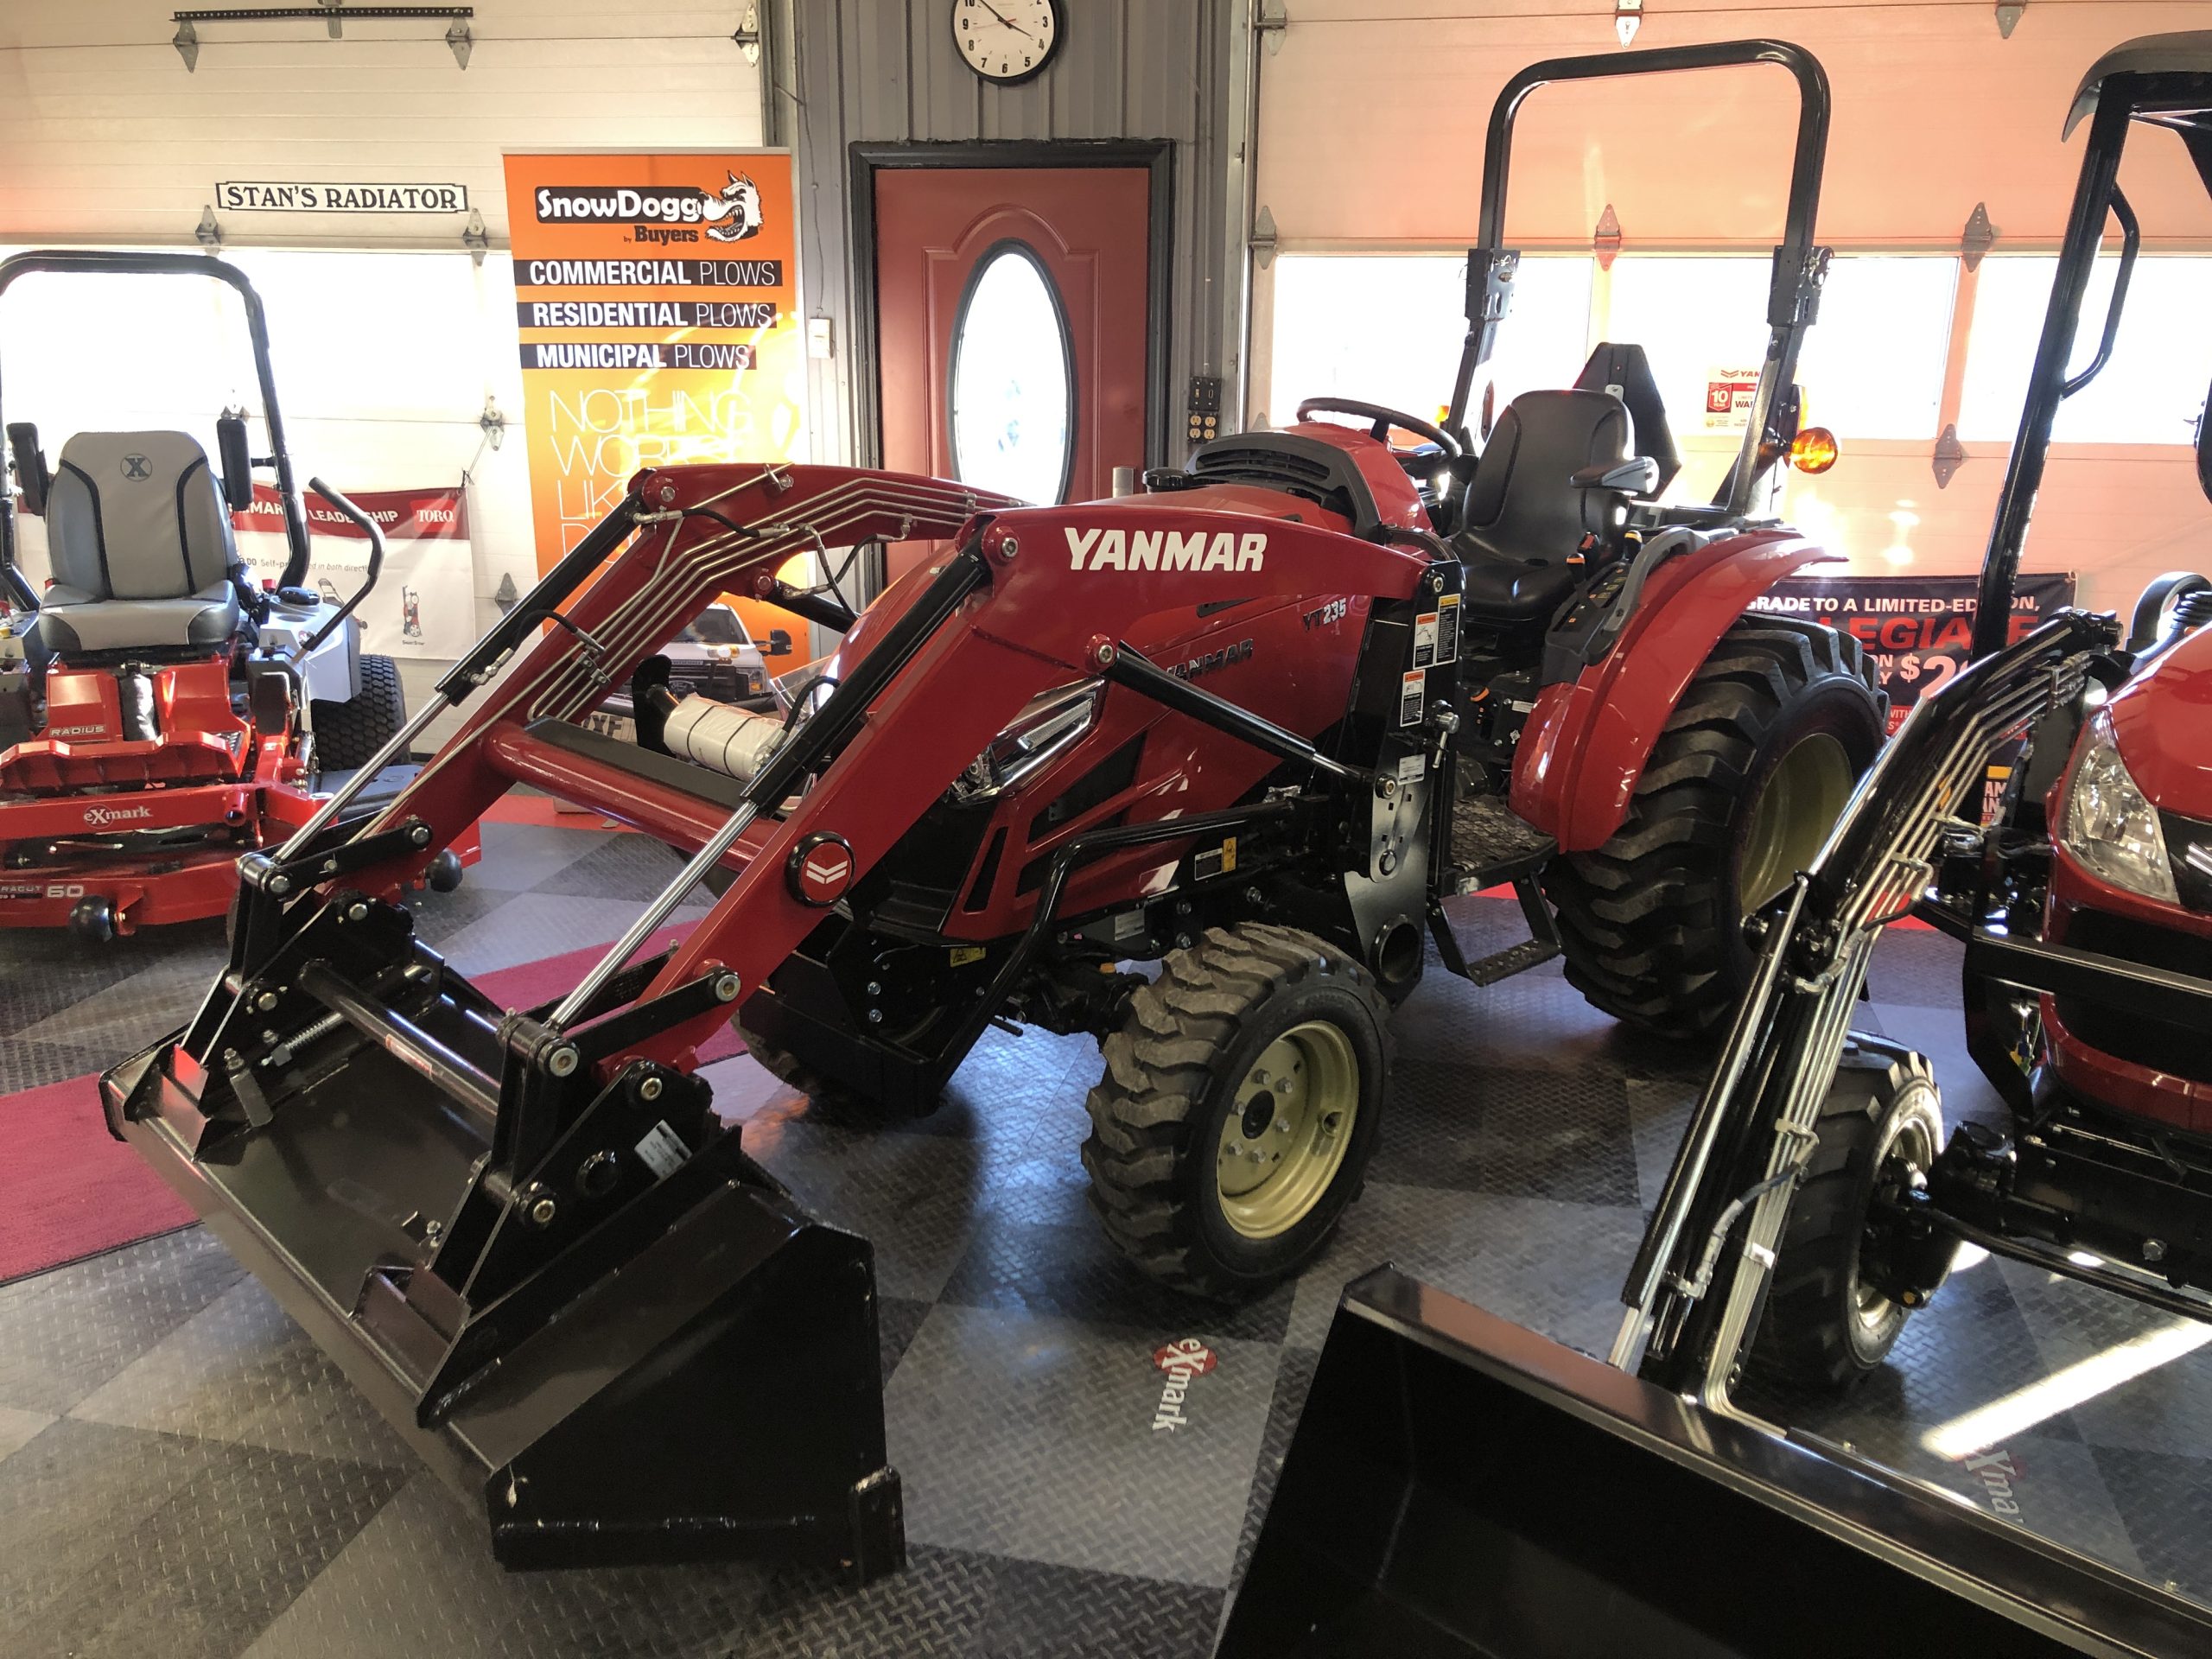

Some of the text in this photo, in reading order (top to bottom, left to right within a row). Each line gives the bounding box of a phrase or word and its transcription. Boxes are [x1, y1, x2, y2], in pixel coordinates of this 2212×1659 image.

[963, 18, 969, 29] 9
[1043, 16, 1048, 28] 3
[969, 40, 975, 51] 8
[1038, 39, 1045, 50] 4
[981, 58, 988, 68] 7
[1002, 63, 1008, 73] 6
[1025, 57, 1031, 67] 5
[226, 185, 458, 209] STAN'S RADIATOR
[537, 189, 702, 222] SnowDogg
[623, 226, 700, 245] by Buyers
[529, 260, 776, 286] COMMERCIAL PLOWS
[532, 302, 772, 328] RESIDENTIAL PLOWS
[536, 344, 751, 370] MUNICIPAL PLOWS
[1712, 390, 1728, 404] 10
[550, 389, 753, 433] NOTHING
[556, 480, 631, 520] LIK
[416, 509, 454, 523] TORO
[1064, 526, 1268, 572] YANMAR
[1814, 597, 1839, 612] TO
[1842, 598, 1859, 612] A
[51, 726, 105, 736] RADIUS
[83, 805, 150, 824] eXmark
[47, 885, 84, 898] 60
[1152, 1338, 1209, 1433] eXmark
